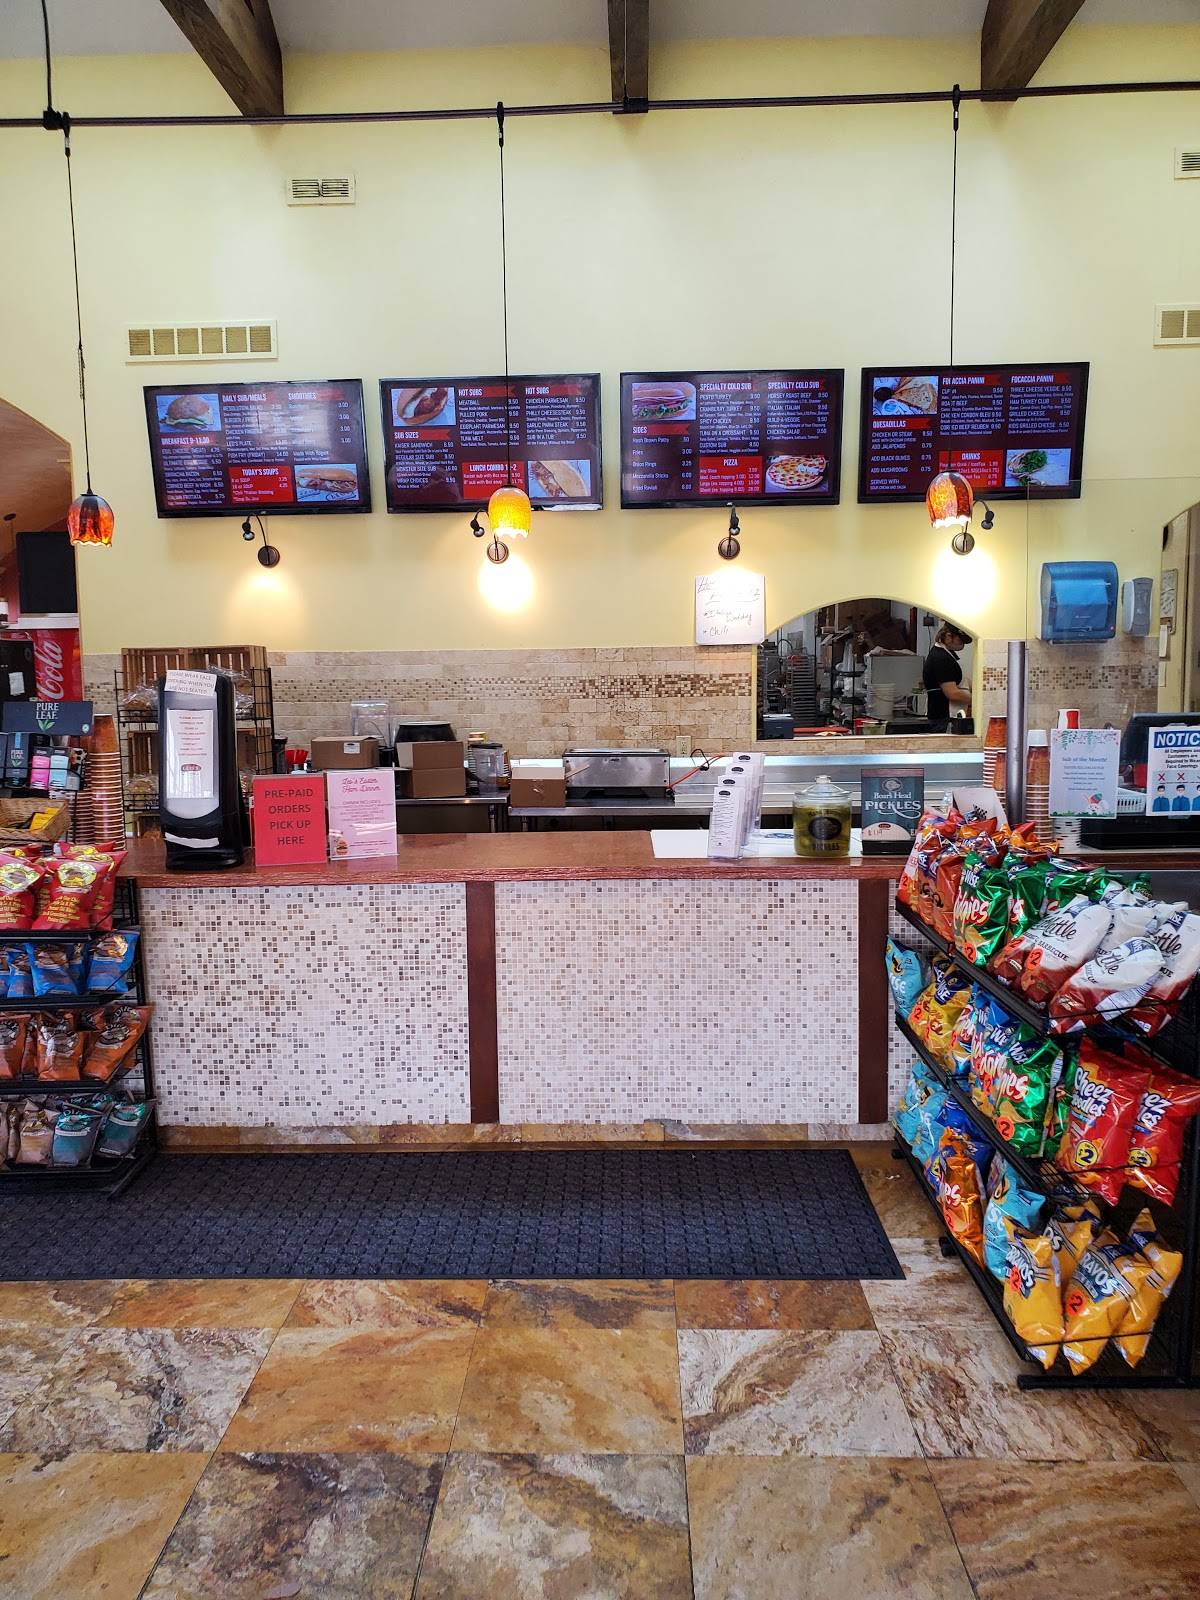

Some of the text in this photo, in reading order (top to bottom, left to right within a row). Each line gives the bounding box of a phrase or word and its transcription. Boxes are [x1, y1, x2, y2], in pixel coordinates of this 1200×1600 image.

[36, 702, 59, 710] PURE
[36, 712, 58, 720] LEAF
[1156, 732, 1200, 746] NOTIC
[264, 788, 313, 798] PRE-PAID
[268, 804, 311, 814] ORDERS
[865, 800, 921, 812] PICKLES
[270, 820, 311, 830] PICK UP
[277, 836, 305, 845] HERE
[1075, 1066, 1114, 1104] Cheez
[1082, 1252, 1118, 1295] RAVOS
